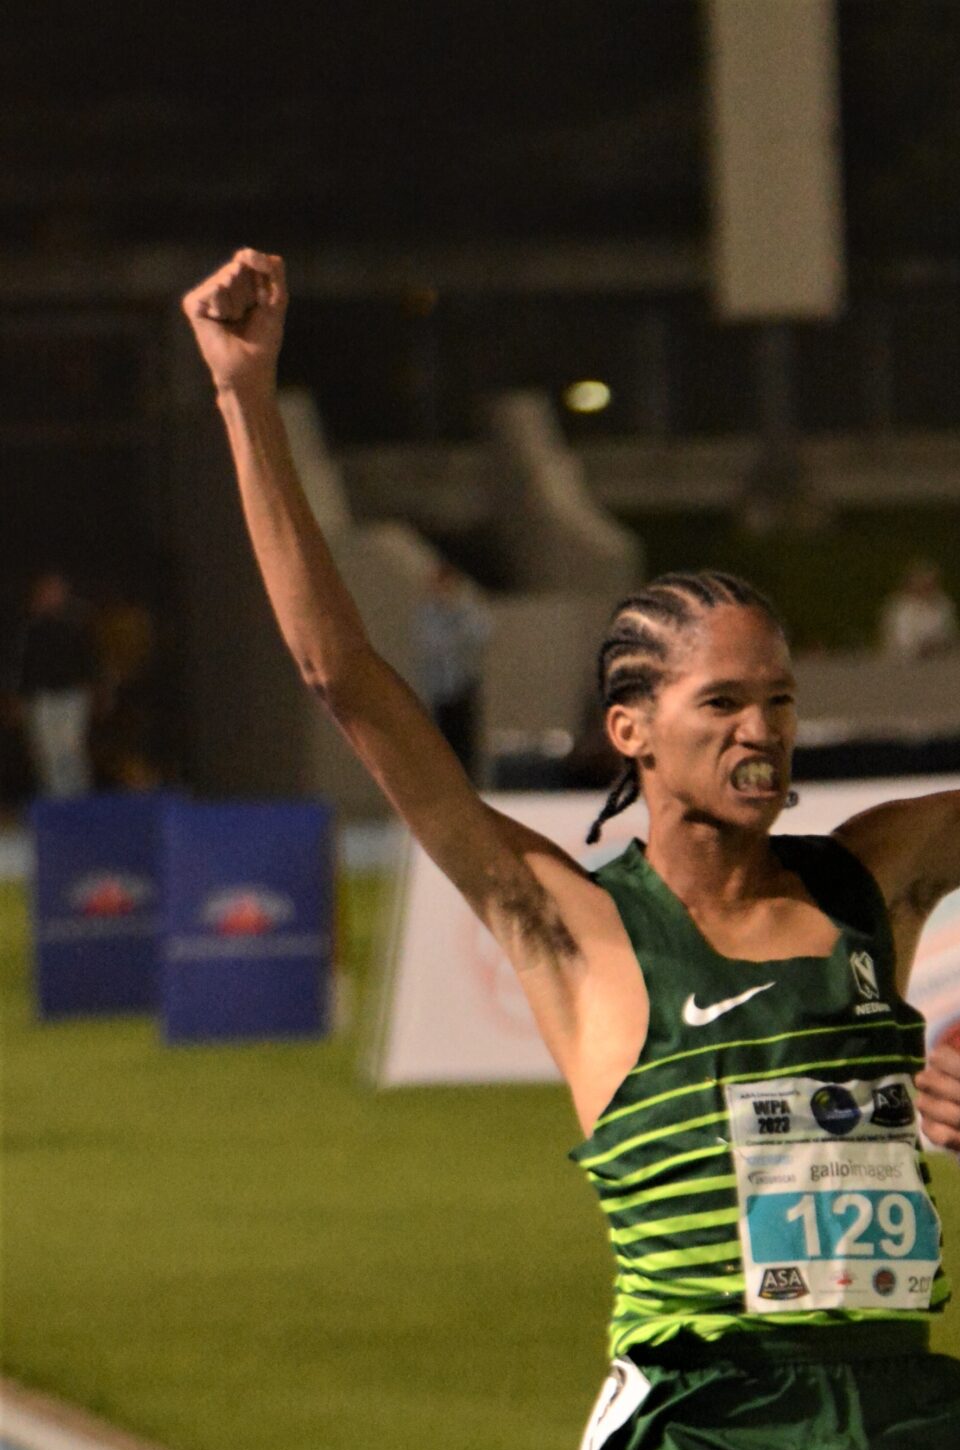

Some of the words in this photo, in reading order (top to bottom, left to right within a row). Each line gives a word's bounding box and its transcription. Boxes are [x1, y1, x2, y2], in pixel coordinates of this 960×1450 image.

[753, 1099, 792, 1116] WPA
[758, 1116, 791, 1135] 2023
[810, 1160, 902, 1182] galloimages
[786, 1193, 917, 1258] 129
[764, 1268, 802, 1289] ASA
